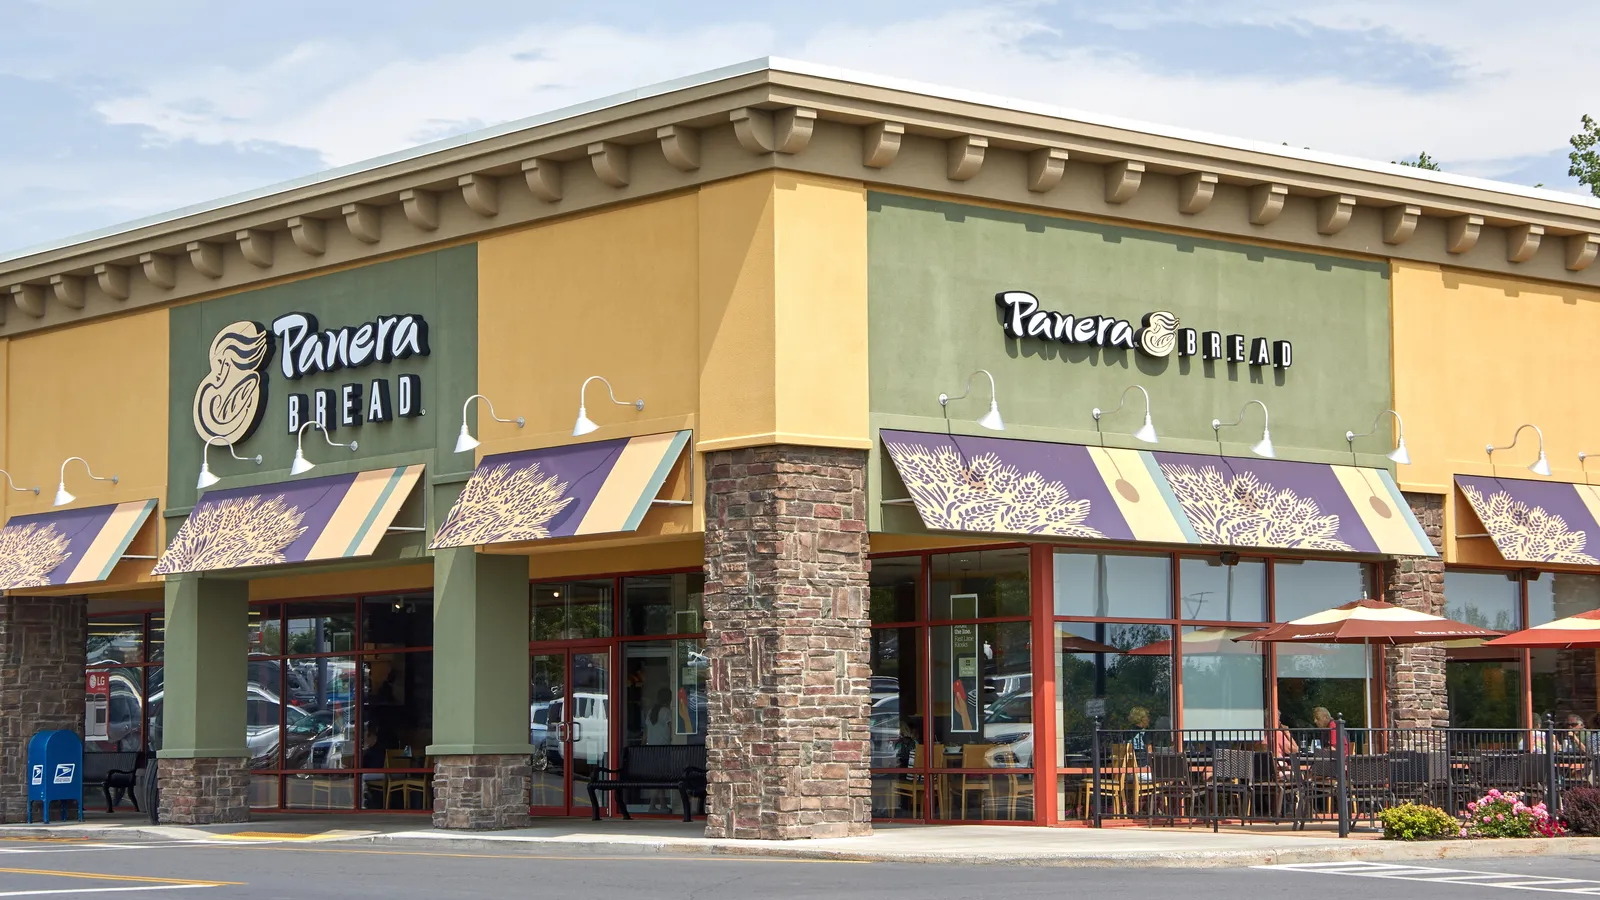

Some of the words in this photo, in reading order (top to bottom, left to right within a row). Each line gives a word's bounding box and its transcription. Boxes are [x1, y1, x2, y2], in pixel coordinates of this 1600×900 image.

[272, 311, 427, 380] Panera
[998, 290, 1134, 349] Panera
[1179, 327, 1293, 369] BREAD
[287, 373, 421, 435] BREAD
